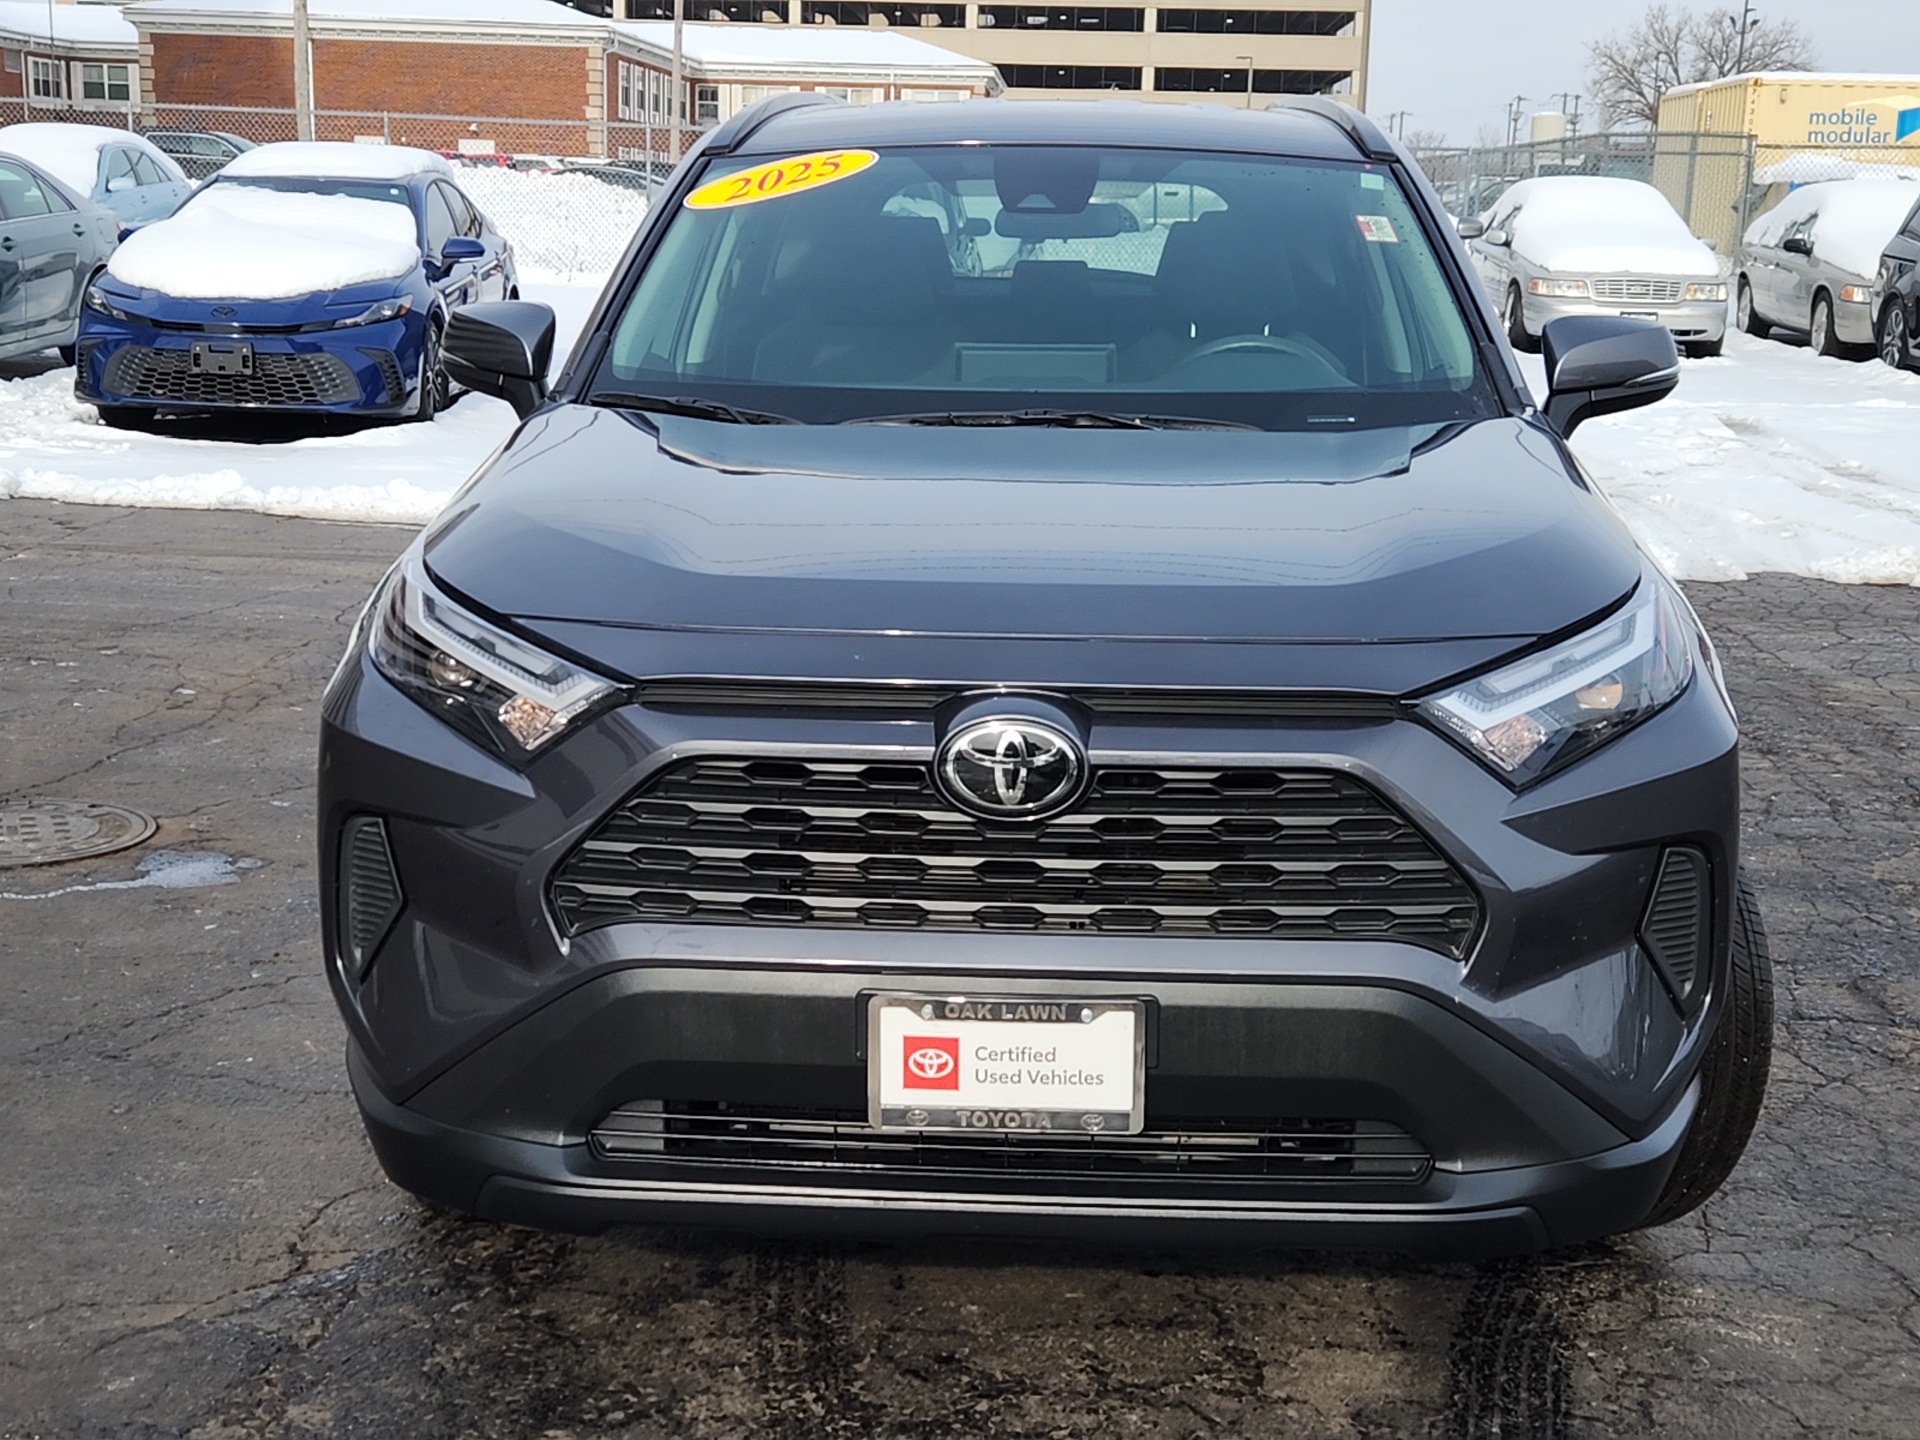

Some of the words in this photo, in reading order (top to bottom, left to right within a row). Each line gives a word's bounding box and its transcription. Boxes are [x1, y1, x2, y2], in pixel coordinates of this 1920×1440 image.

[1809, 108, 1878, 126] mobile
[1807, 126, 1891, 144] modular
[724, 153, 844, 202] 2025
[944, 1003, 993, 1019] OAK
[1001, 1003, 1067, 1020] LAWN
[975, 1046, 1057, 1063] Certified
[975, 1069, 1022, 1085] Used
[1027, 1070, 1104, 1086] Vehicles
[956, 1110, 1052, 1128] TOYOTA
